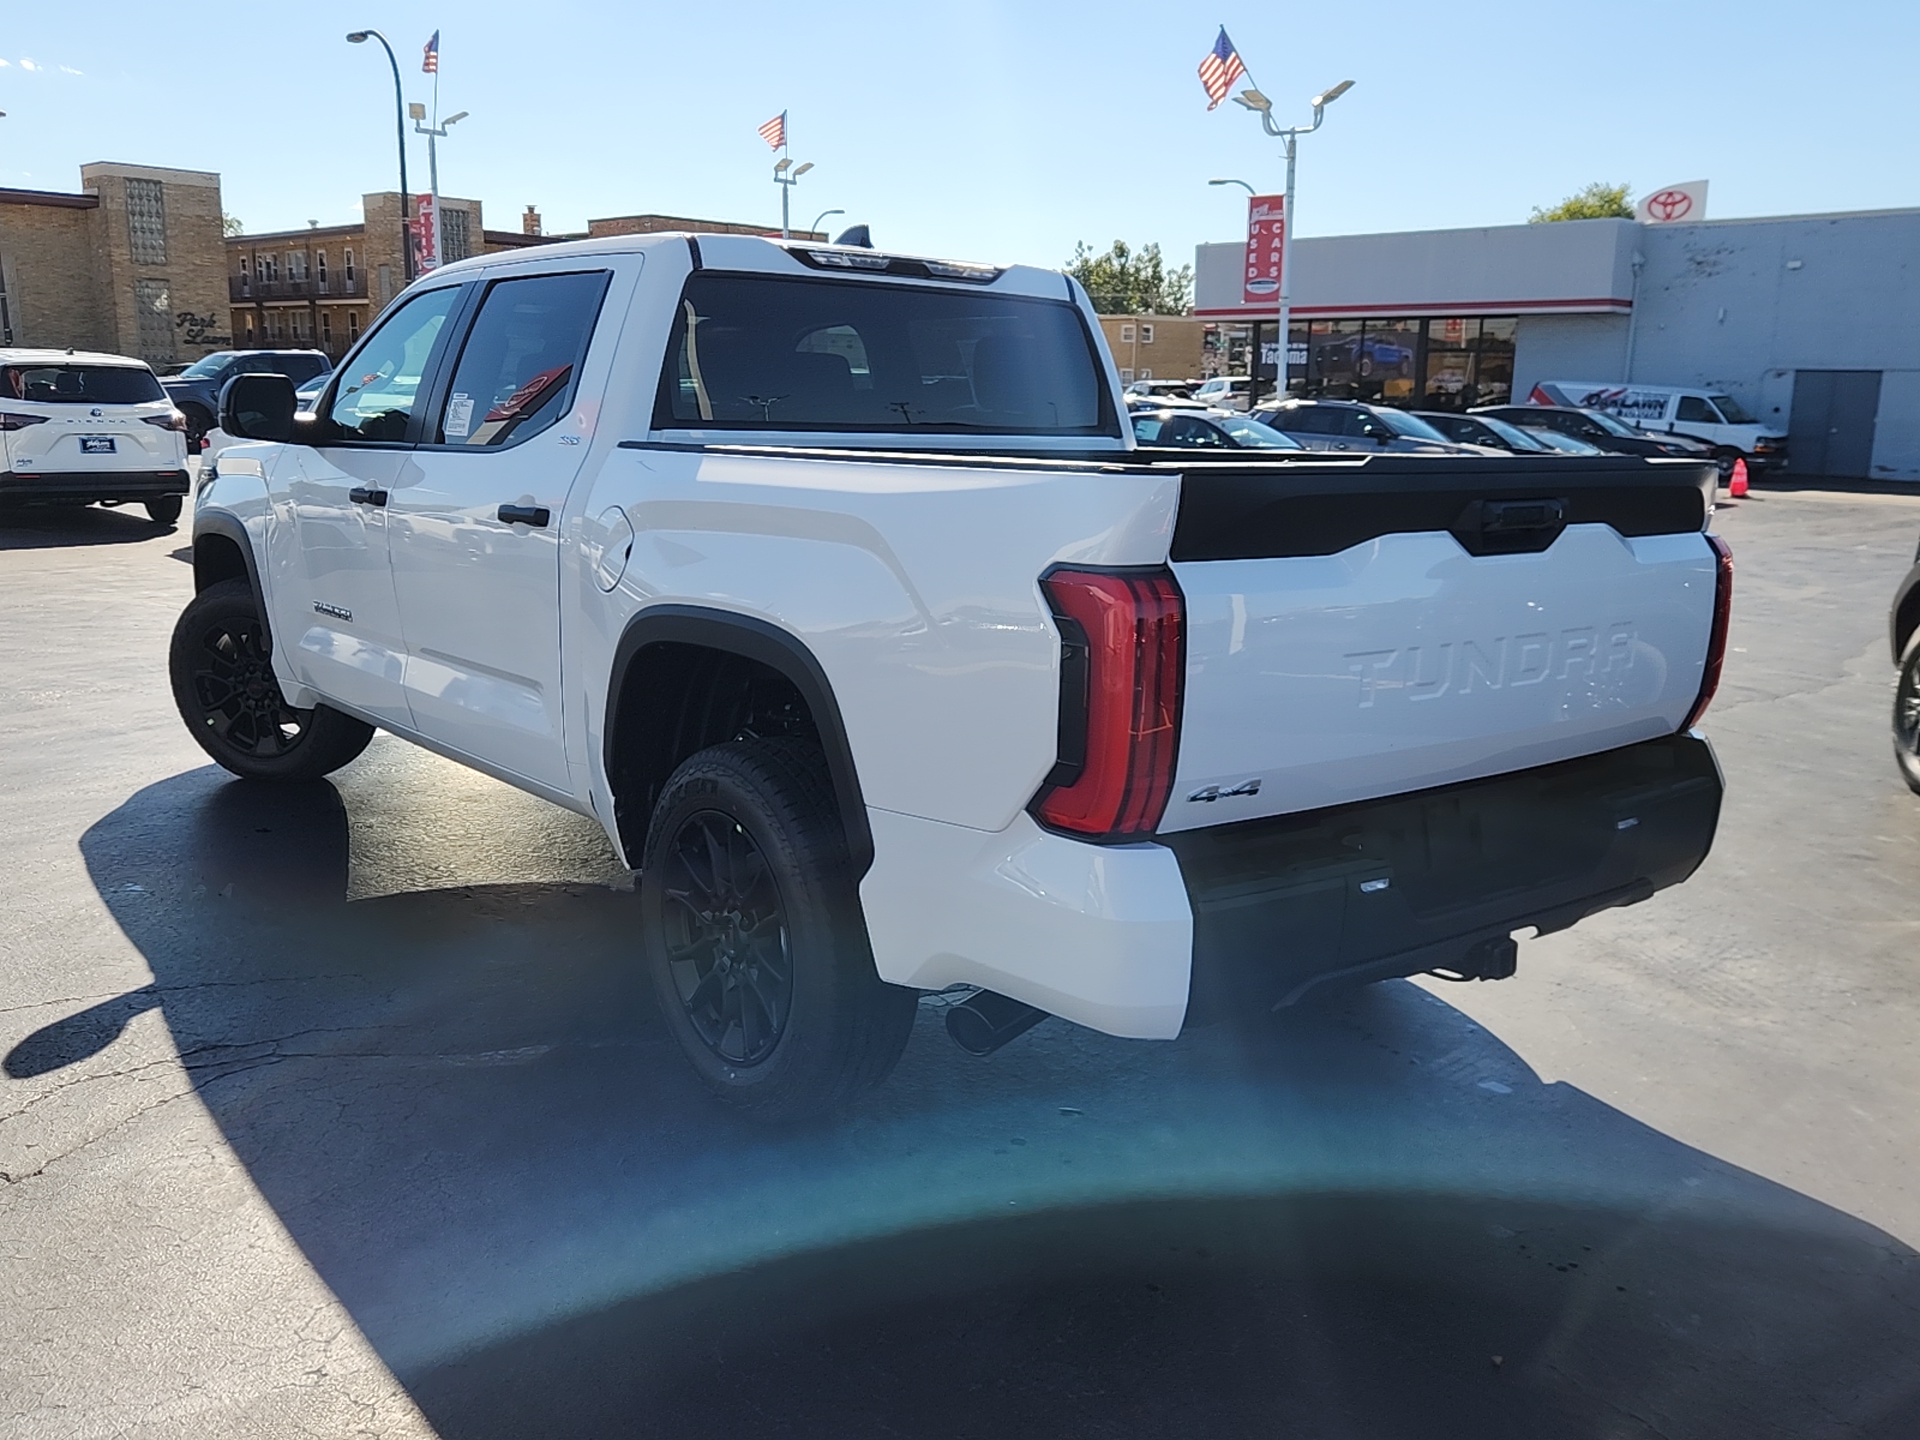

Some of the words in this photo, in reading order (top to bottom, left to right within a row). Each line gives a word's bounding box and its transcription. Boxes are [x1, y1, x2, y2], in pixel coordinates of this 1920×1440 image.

[1248, 223, 1260, 278] USED
[1269, 222, 1282, 277] CARS
[176, 311, 216, 328] Park
[1260, 349, 1308, 365] Tacma
[1342, 621, 1639, 708] TUNDRA
